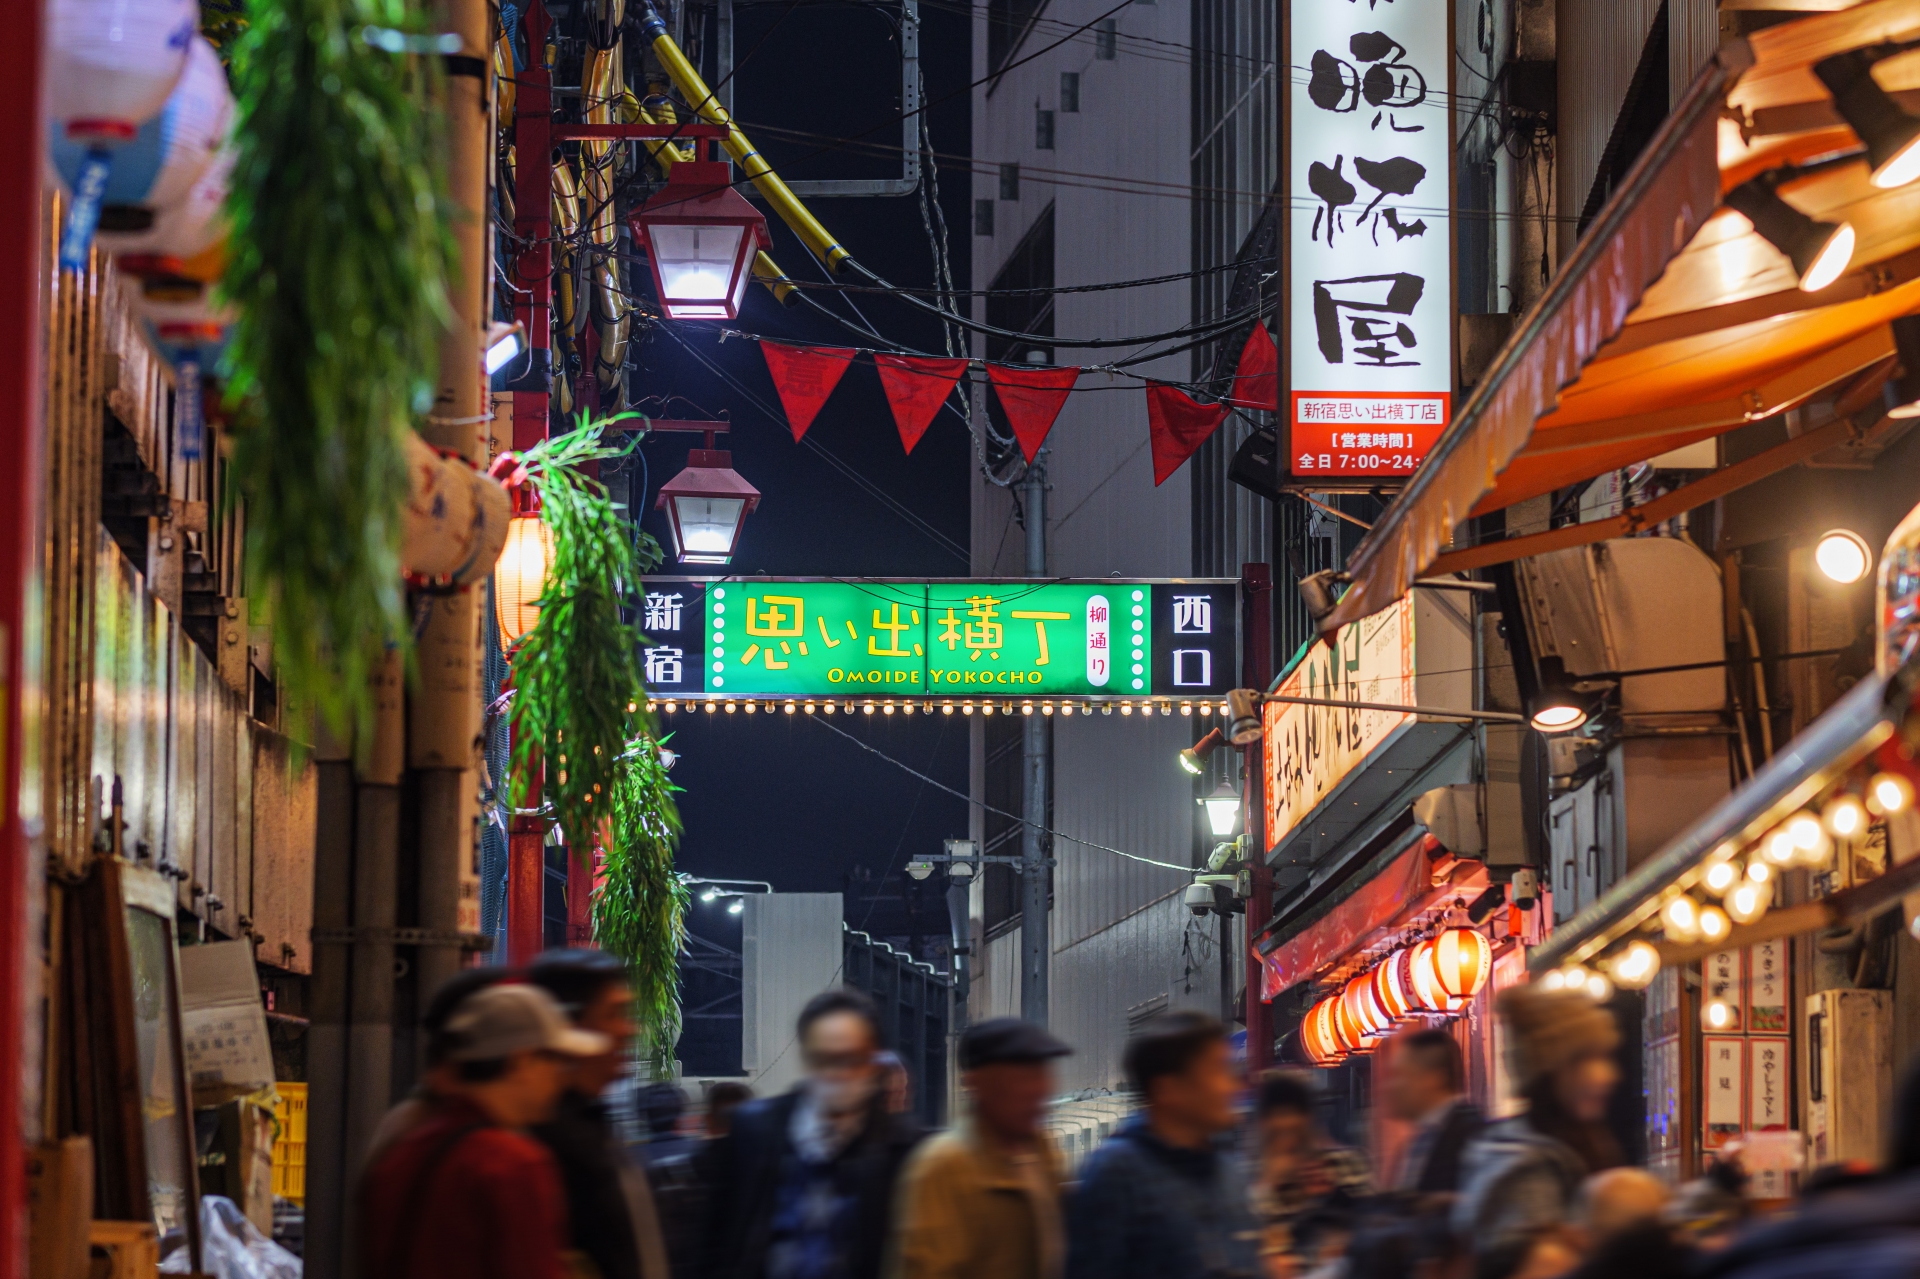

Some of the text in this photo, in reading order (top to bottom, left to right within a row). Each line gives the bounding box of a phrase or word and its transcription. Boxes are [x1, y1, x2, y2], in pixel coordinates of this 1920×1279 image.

[1308, 0, 1428, 367] 晩杯屋
[1303, 402, 1437, 421] 新宿思い出横丁店
[1298, 453, 1331, 469] 全日
[644, 592, 684, 684] 新宿
[739, 594, 1071, 671] 思い出横丁
[1089, 605, 1107, 676] 柳通り
[1172, 594, 1212, 687] 西口
[827, 667, 1043, 684] OMOIDE YOKOCHO
[1762, 1048, 1775, 1118] 冷やしトマト
